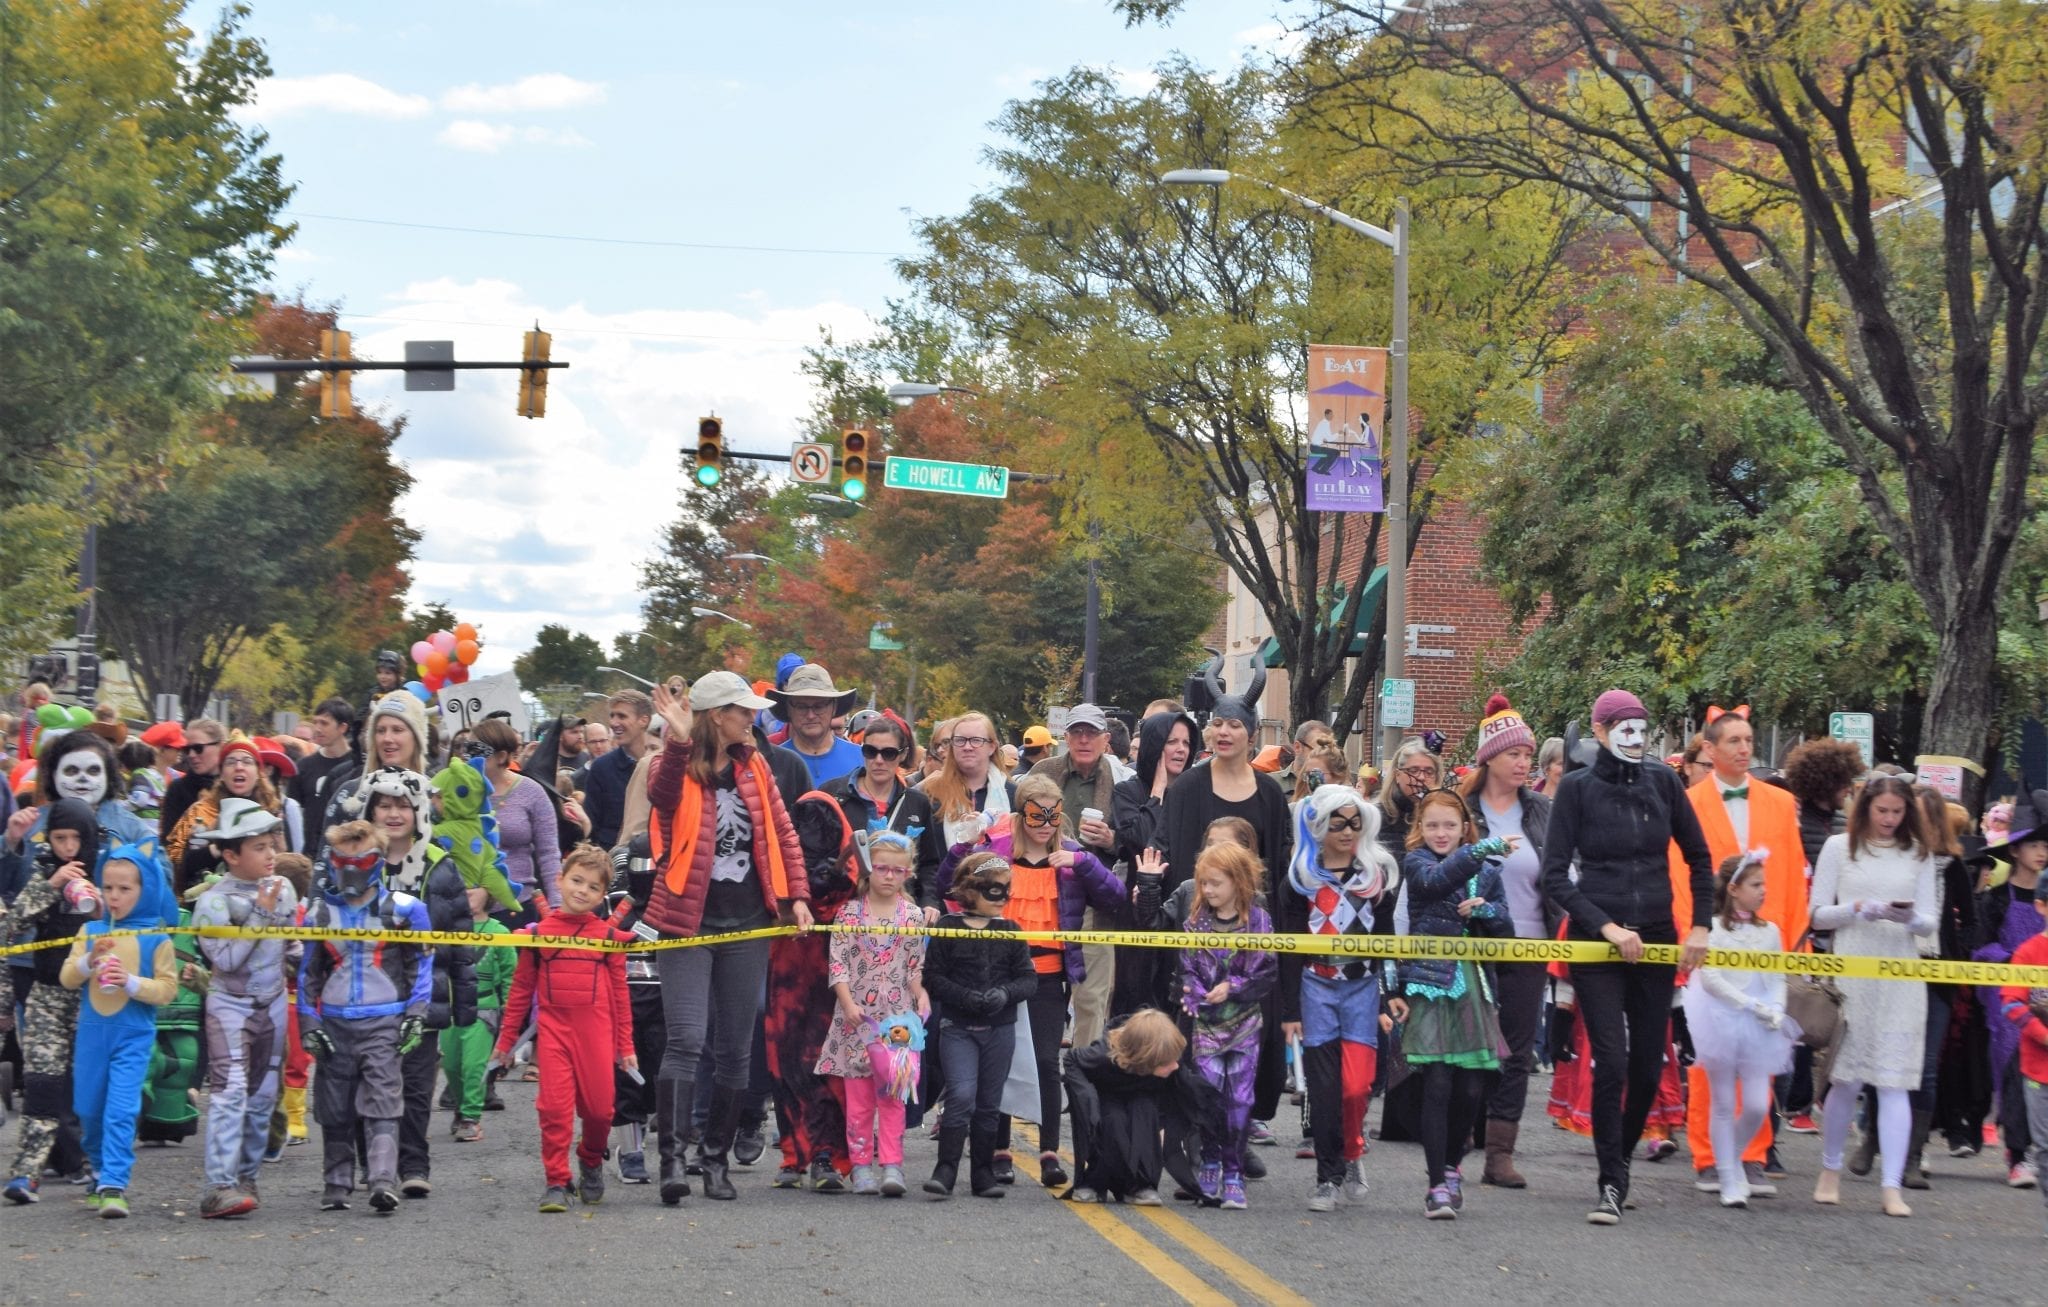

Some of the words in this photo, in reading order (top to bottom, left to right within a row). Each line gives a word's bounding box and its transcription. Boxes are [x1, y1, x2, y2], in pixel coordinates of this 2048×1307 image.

[1324, 357, 1370, 374] EAT
[890, 463, 899, 482] E
[909, 464, 965, 489] HOWELL
[976, 471, 1002, 492] AVE
[1385, 683, 1392, 694] 2
[1833, 717, 1842, 735] 2
[955, 928, 1017, 939] CROSS
[1121, 934, 1158, 945] LINE
[1164, 935, 1189, 946] DO
[1194, 936, 1230, 948] NOT
[1235, 936, 1296, 951] CROSS
[1332, 938, 1395, 953] POLICE
[1400, 939, 1437, 955] LINE
[1442, 940, 1467, 956] DO
[1472, 941, 1507, 958] NOT
[1512, 942, 1573, 959] CROSS
[1608, 944, 1669, 962] PICE
[1716, 950, 1741, 966] DO
[1745, 952, 1781, 969] NOT
[1785, 954, 1844, 973] CROSS
[1878, 960, 1940, 978] POLICE
[1944, 963, 1981, 980] LINE
[1986, 966, 2010, 982] DO
